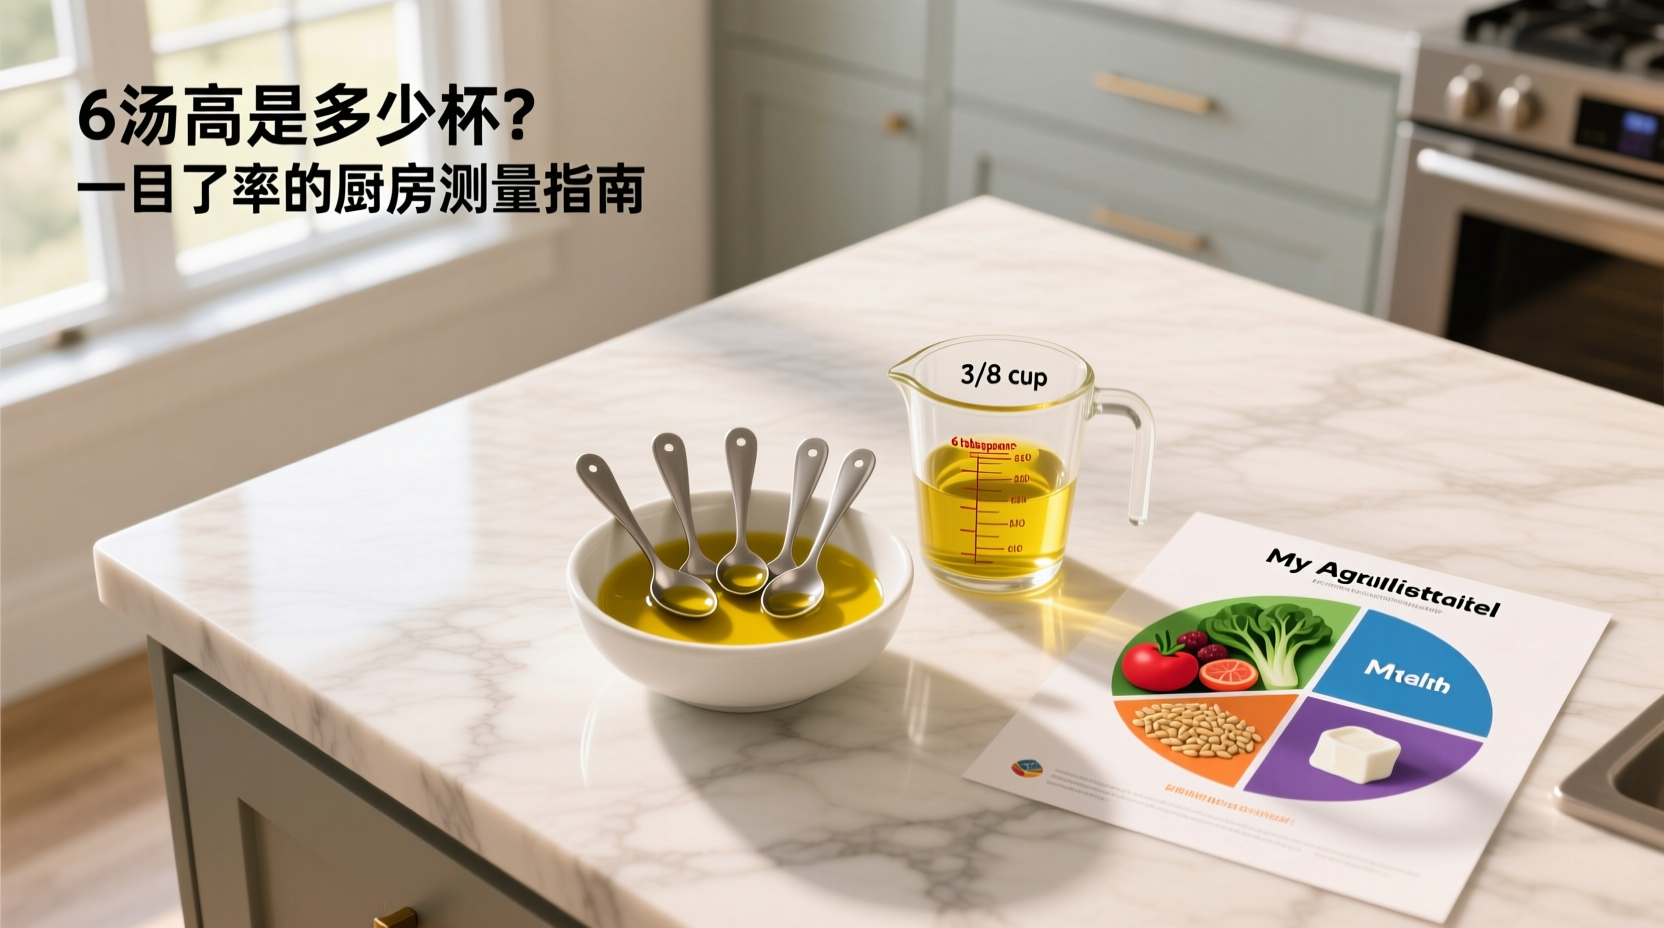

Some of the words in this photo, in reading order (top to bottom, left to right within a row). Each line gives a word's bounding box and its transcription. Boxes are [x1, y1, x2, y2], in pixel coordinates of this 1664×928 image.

[961, 361, 1002, 388] 3/8
[1008, 369, 1048, 392] cup
[1266, 548, 1313, 574] My
